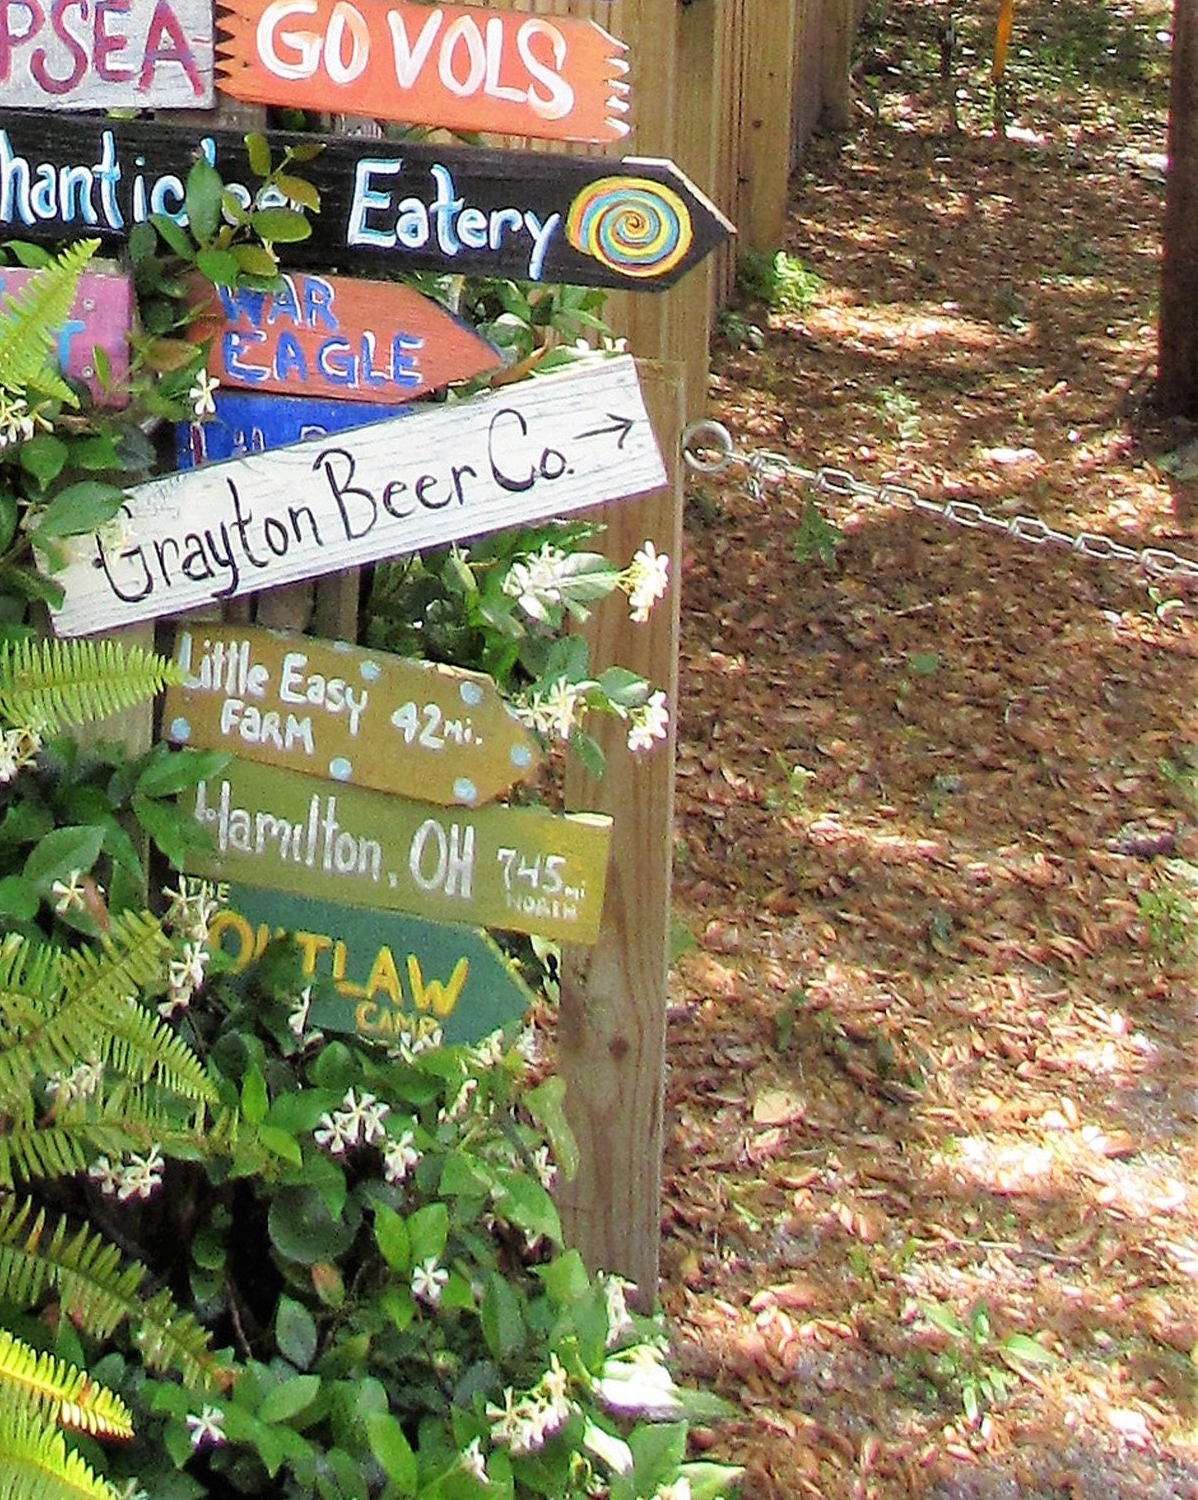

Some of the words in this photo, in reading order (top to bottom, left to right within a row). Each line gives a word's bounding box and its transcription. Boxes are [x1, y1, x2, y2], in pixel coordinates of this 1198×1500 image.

[386, 8, 575, 120] VOLS
[348, 157, 561, 281] Eatery
[215, 274, 339, 331] WAR
[222, 329, 424, 389] EAGLE
[94, 477, 325, 602] Grayton
[313, 447, 478, 541] Beer
[488, 408, 575, 493] Co.
[280, 652, 369, 737] Easy
[409, 818, 475, 899] OH
